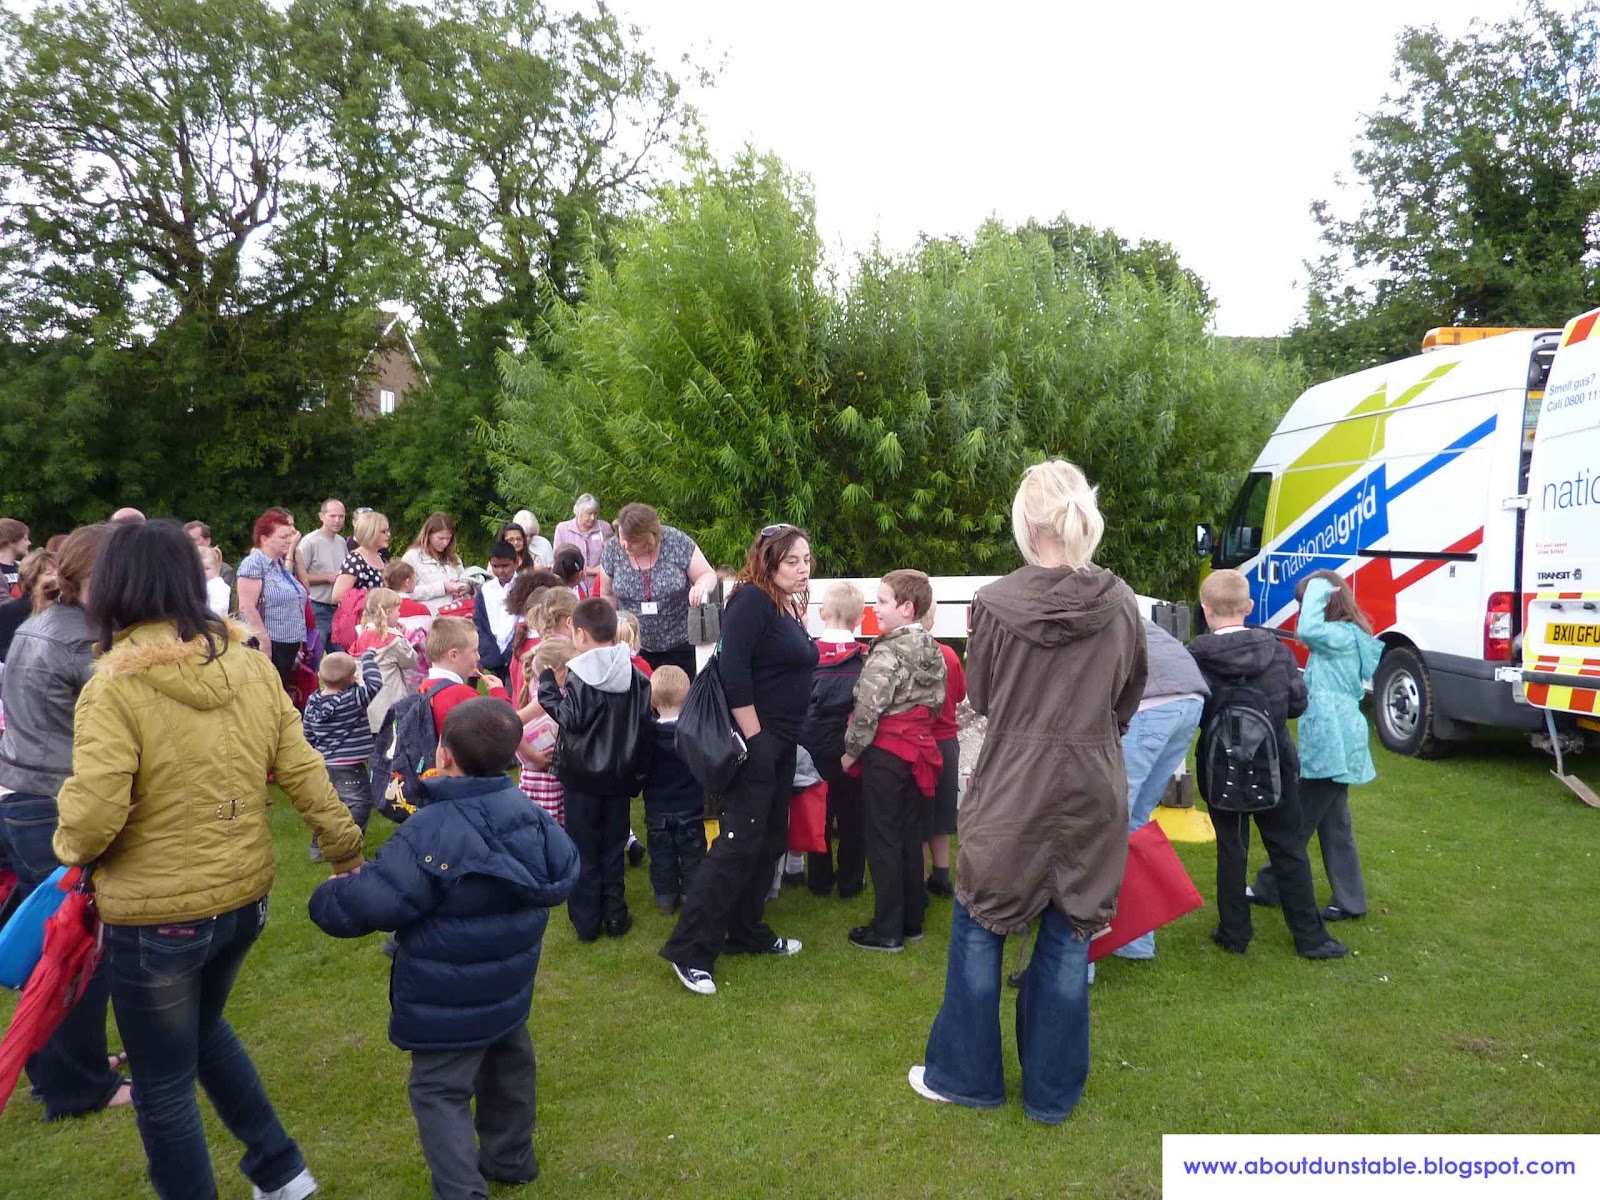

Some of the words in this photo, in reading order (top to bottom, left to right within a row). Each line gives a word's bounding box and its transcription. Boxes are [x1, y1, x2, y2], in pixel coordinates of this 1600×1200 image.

[1549, 380, 1572, 396] Smell
[1573, 373, 1596, 391] gas?
[1547, 400, 1563, 412] Call
[1564, 392, 1585, 408] 0800
[1587, 389, 1600, 401] 11
[1536, 571, 1571, 581] TRANSIT
[1552, 624, 1575, 642] BX11
[1577, 625, 1600, 643] GFU
